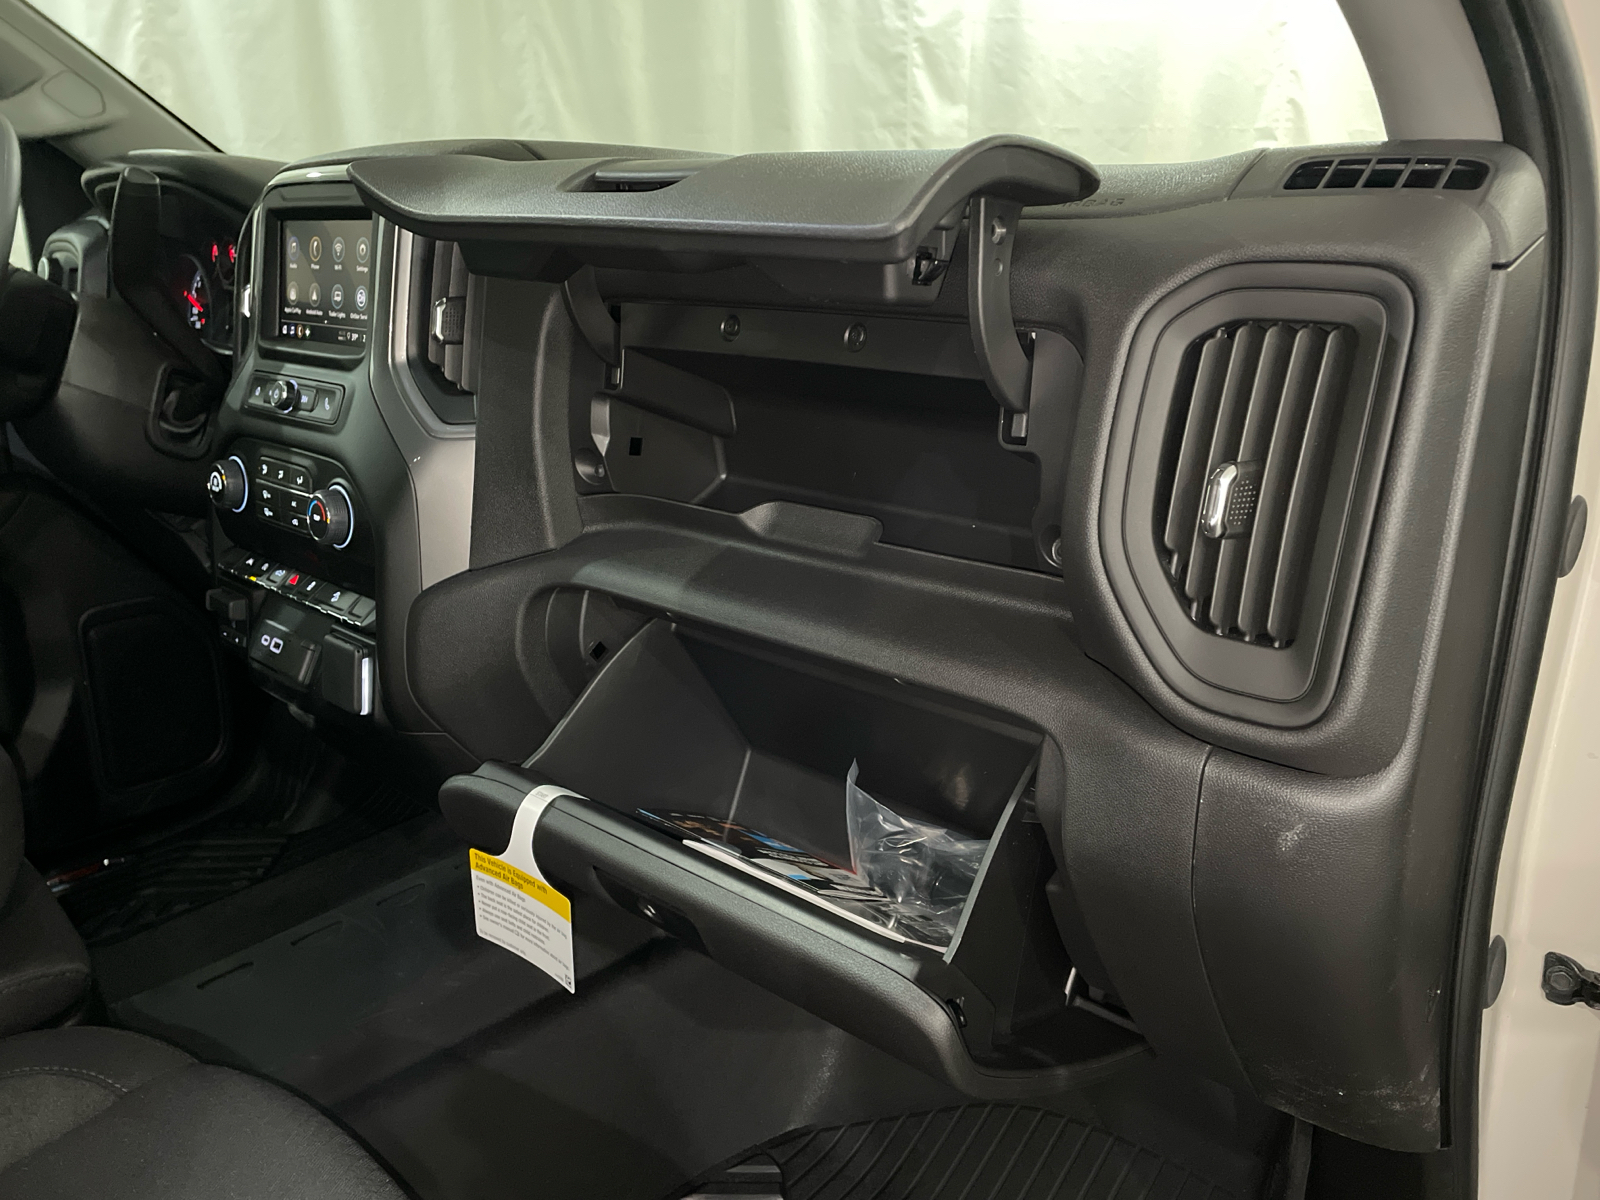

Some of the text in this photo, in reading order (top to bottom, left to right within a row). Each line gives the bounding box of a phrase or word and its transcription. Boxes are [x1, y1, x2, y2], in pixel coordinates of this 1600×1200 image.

[475, 853, 547, 895] This Vehicle is Equipped with
[475, 861, 501, 878] Advanced
[511, 877, 523, 891] Bags
